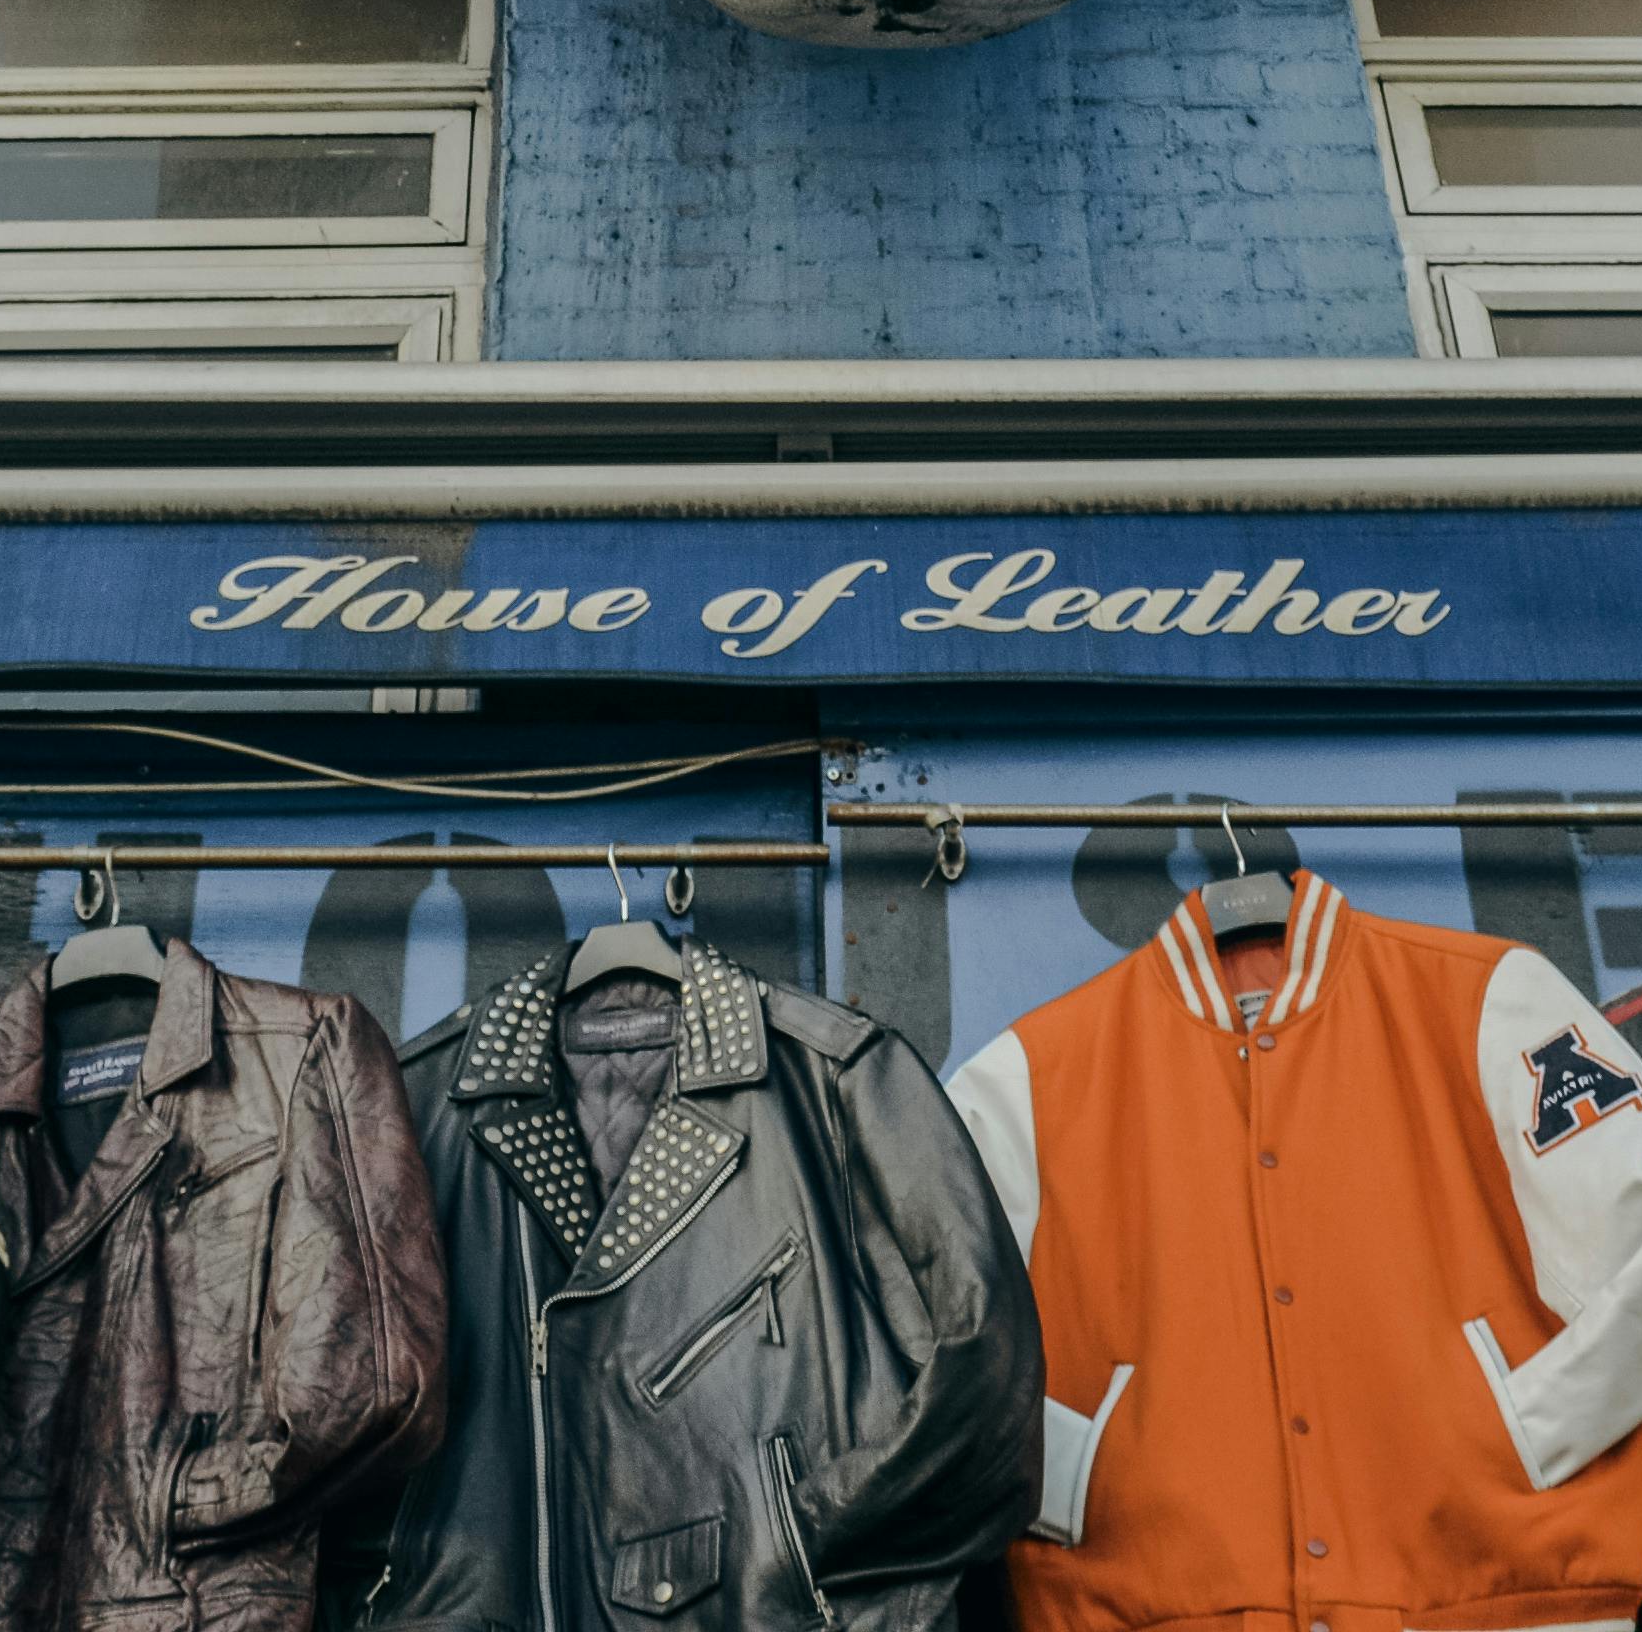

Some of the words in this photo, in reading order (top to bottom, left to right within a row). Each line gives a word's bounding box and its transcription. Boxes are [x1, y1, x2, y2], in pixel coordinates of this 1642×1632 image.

[190, 555, 652, 632] House
[701, 558, 888, 658] of
[900, 547, 1451, 636] Leather
